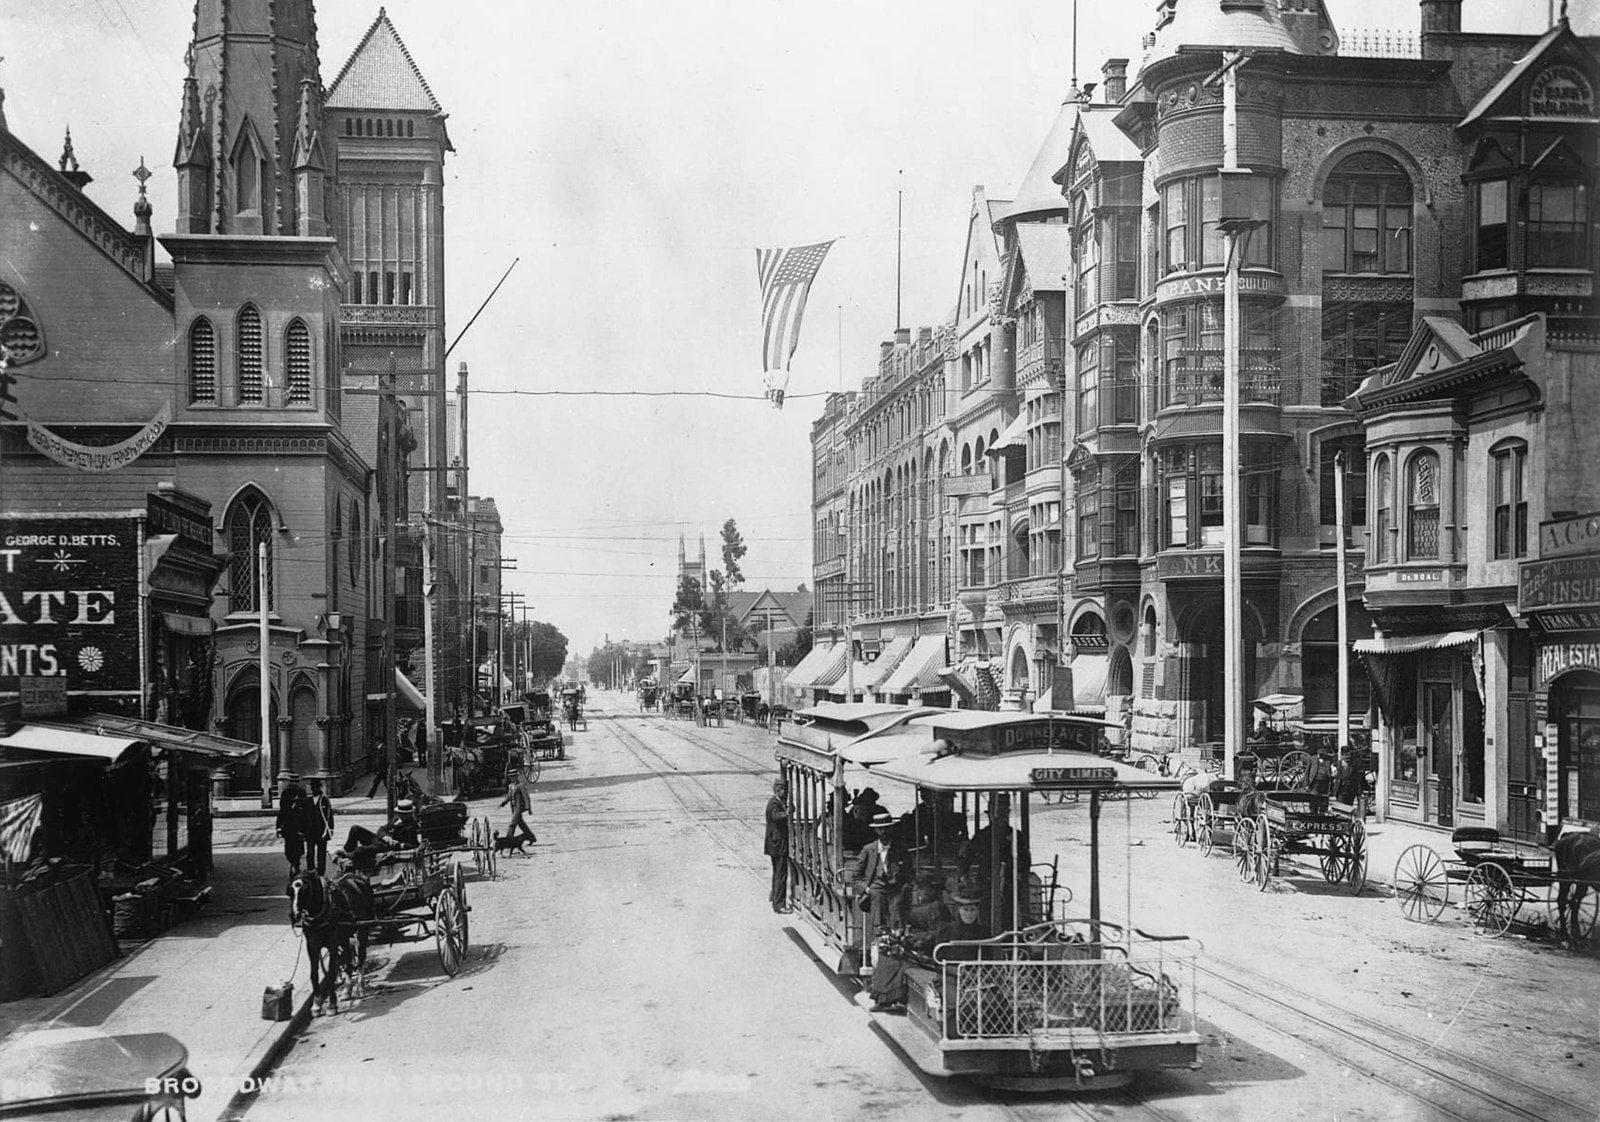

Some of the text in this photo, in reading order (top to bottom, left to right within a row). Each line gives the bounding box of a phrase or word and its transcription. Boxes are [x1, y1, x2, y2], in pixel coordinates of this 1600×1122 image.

[5, 535, 56, 546] GEORGE
[1541, 645, 1566, 683] REAL
[1035, 768, 1113, 780] CITY LIMITS
[1292, 821, 1343, 831] EXPRESS
